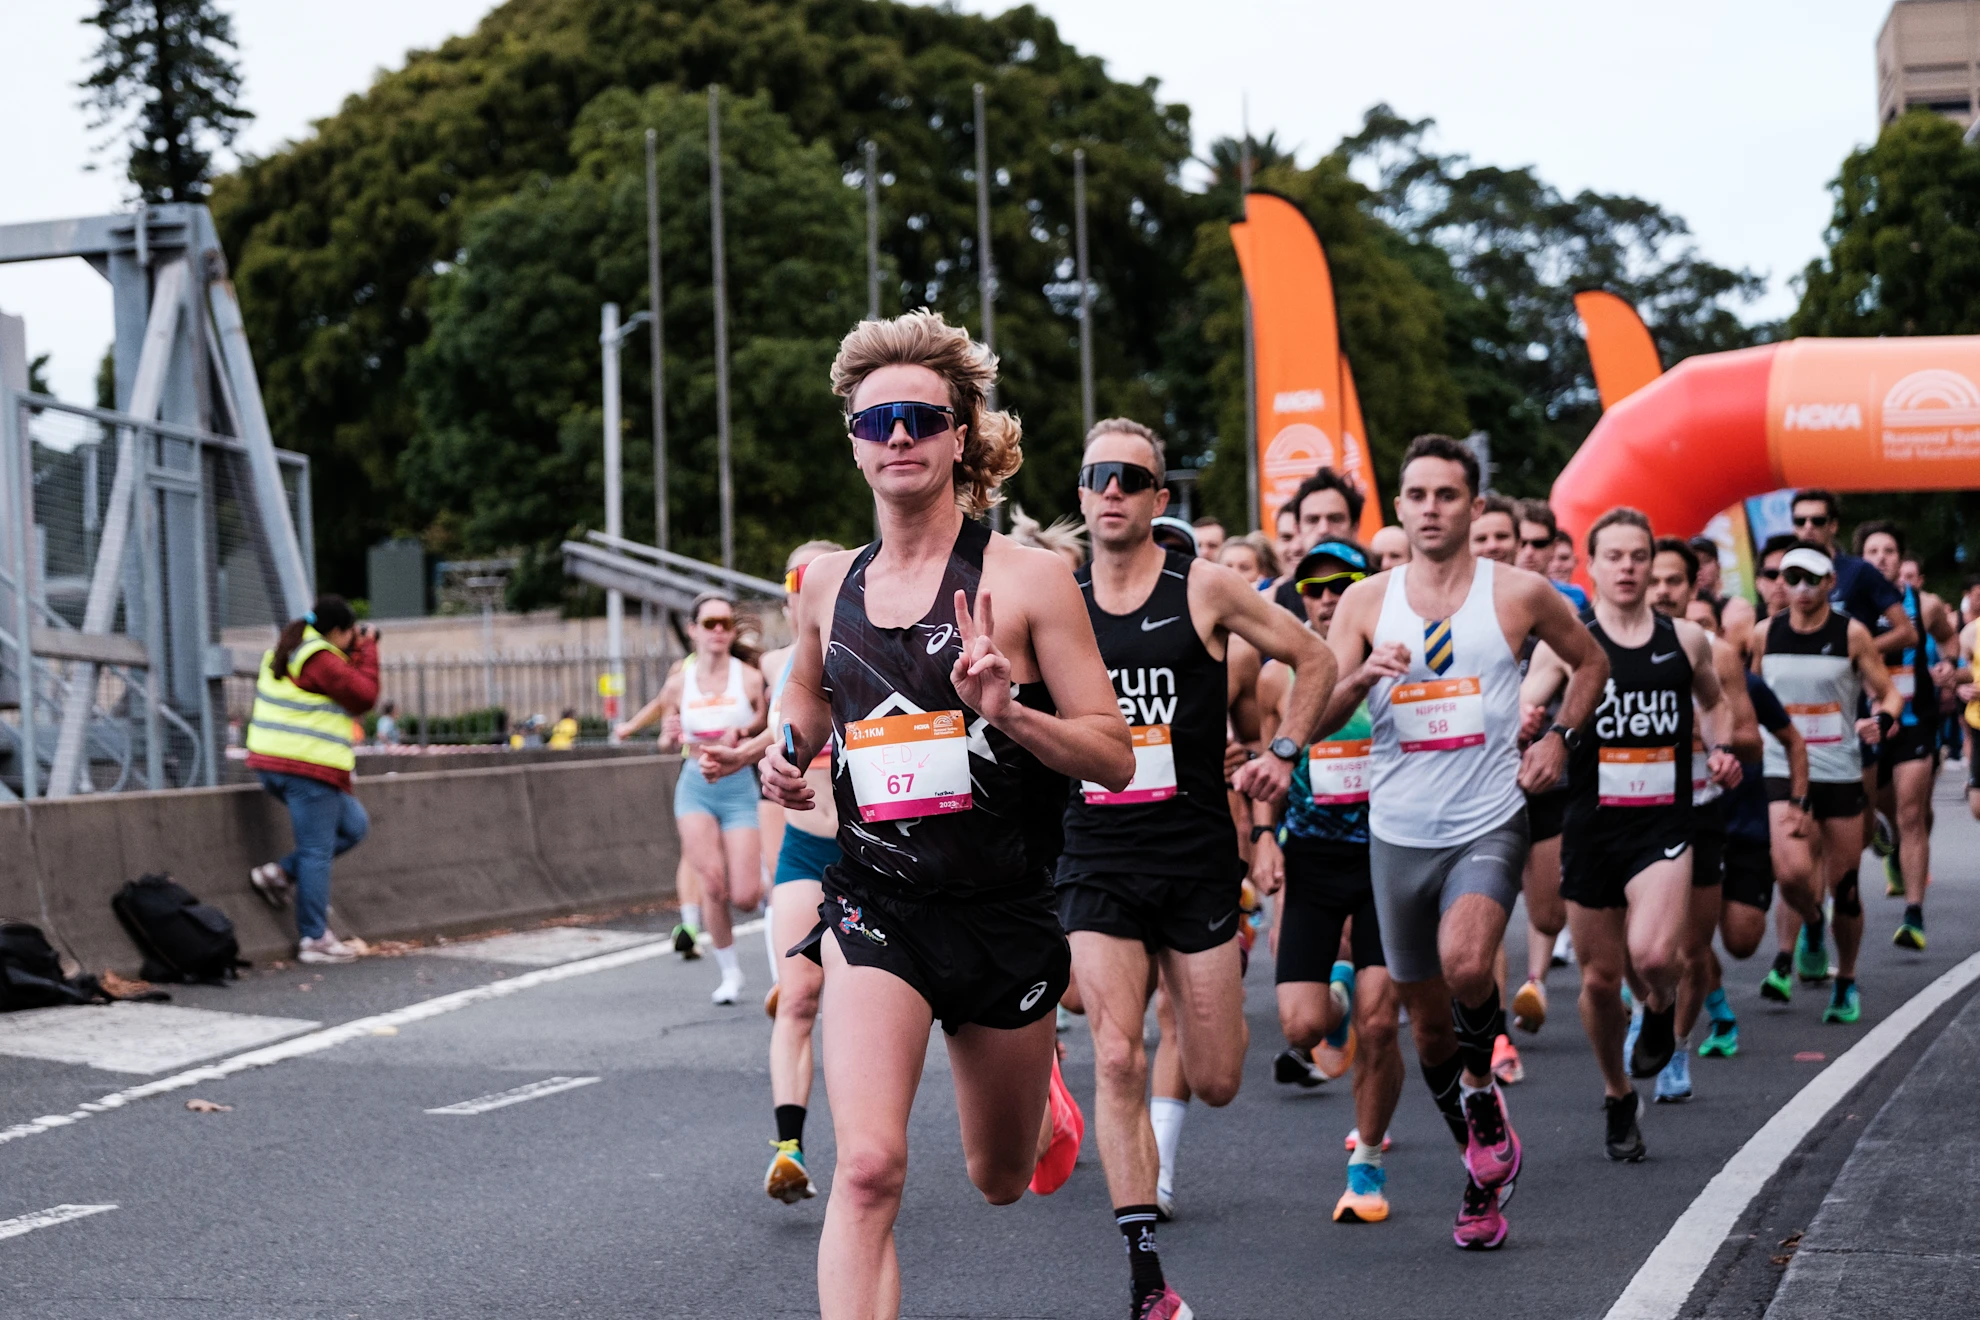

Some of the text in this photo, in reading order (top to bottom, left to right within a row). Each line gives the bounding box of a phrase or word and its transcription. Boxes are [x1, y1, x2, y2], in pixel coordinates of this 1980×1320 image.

[1784, 403, 1862, 430] HOKA
[1117, 696, 1178, 725] ew
[1416, 703, 1456, 716] NIPPER
[1623, 690, 1677, 714] run
[853, 727, 884, 740] 21.1KM
[1428, 719, 1448, 734] 58
[1596, 711, 1679, 739] crew
[887, 773, 915, 795] 67
[1343, 775, 1361, 789] 52
[1630, 780, 1646, 792] 17
